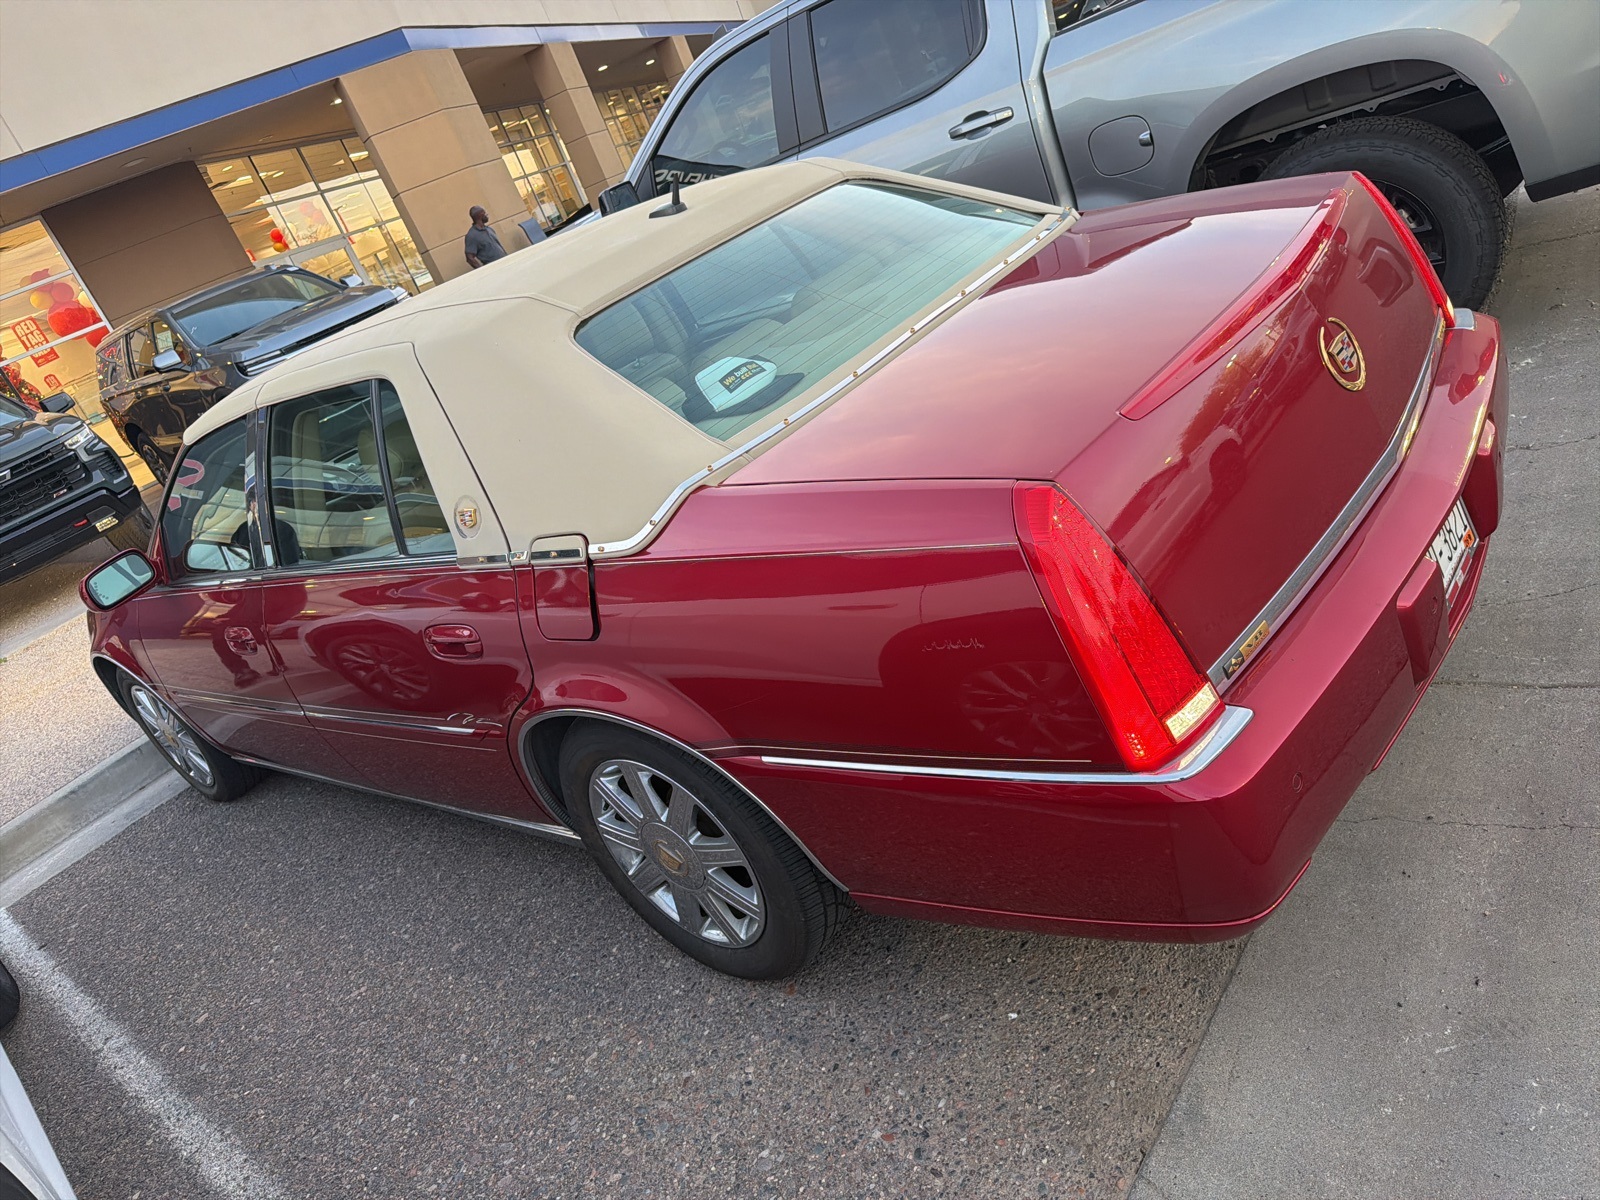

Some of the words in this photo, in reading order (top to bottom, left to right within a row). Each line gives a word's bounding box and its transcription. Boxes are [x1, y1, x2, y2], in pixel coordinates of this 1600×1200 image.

[15, 320, 37, 337] RED
[21, 330, 45, 347] TAG
[723, 376, 736, 386] We
